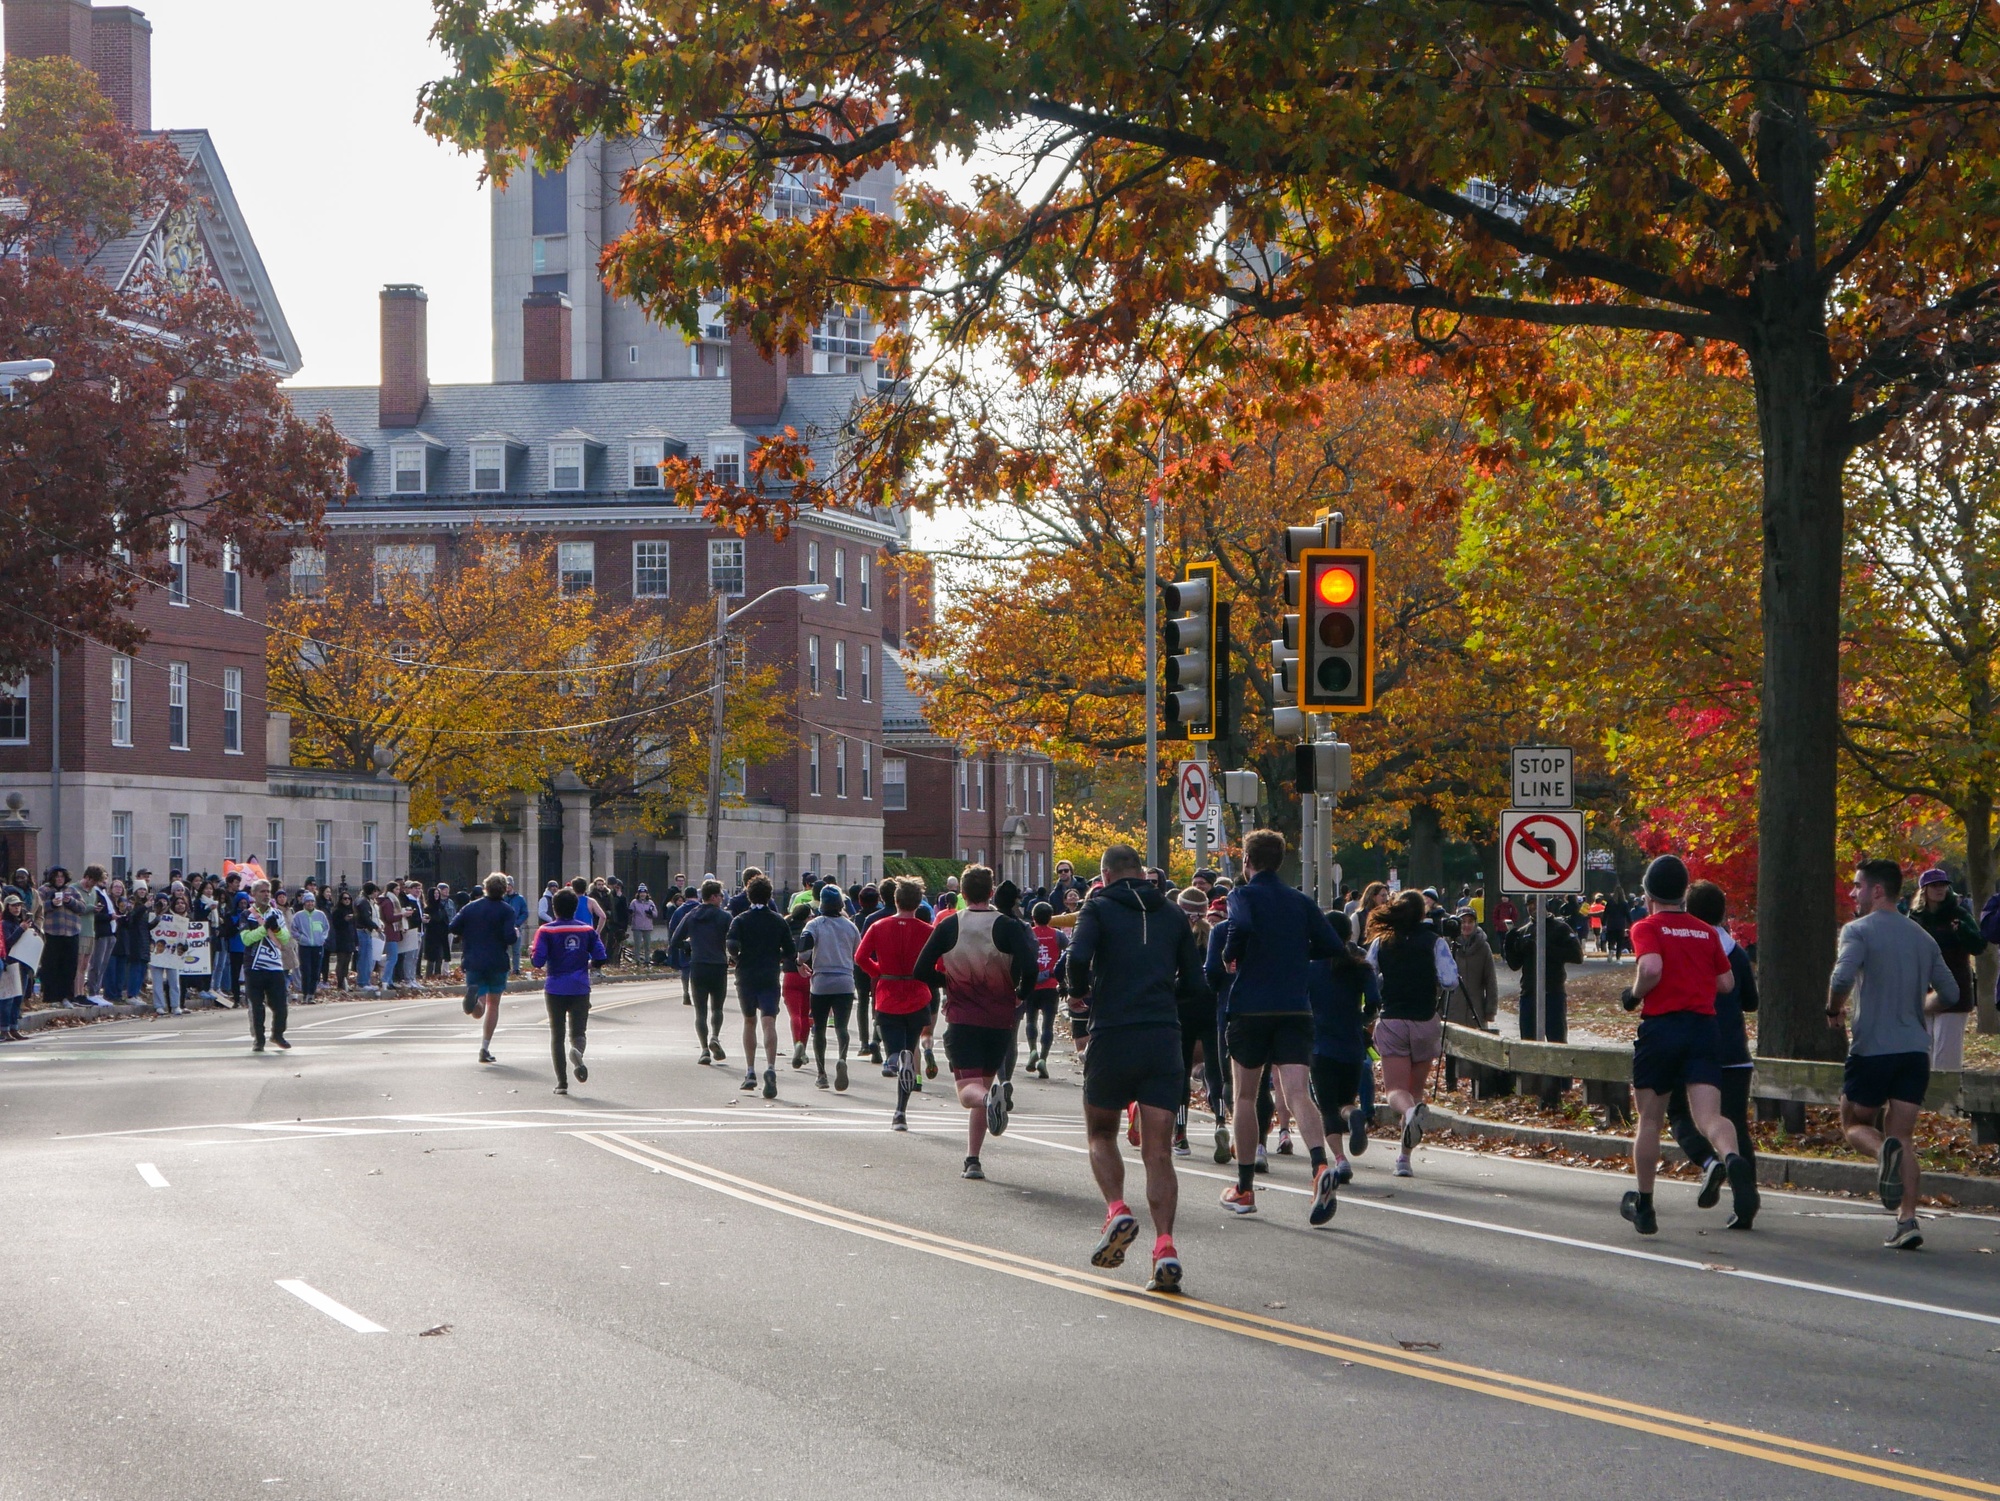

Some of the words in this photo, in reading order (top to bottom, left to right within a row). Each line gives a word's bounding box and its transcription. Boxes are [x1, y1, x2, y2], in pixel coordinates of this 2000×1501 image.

[1520, 758, 1565, 774] STOP
[1521, 781, 1565, 797] LINE
[1187, 827, 1216, 844] 35
